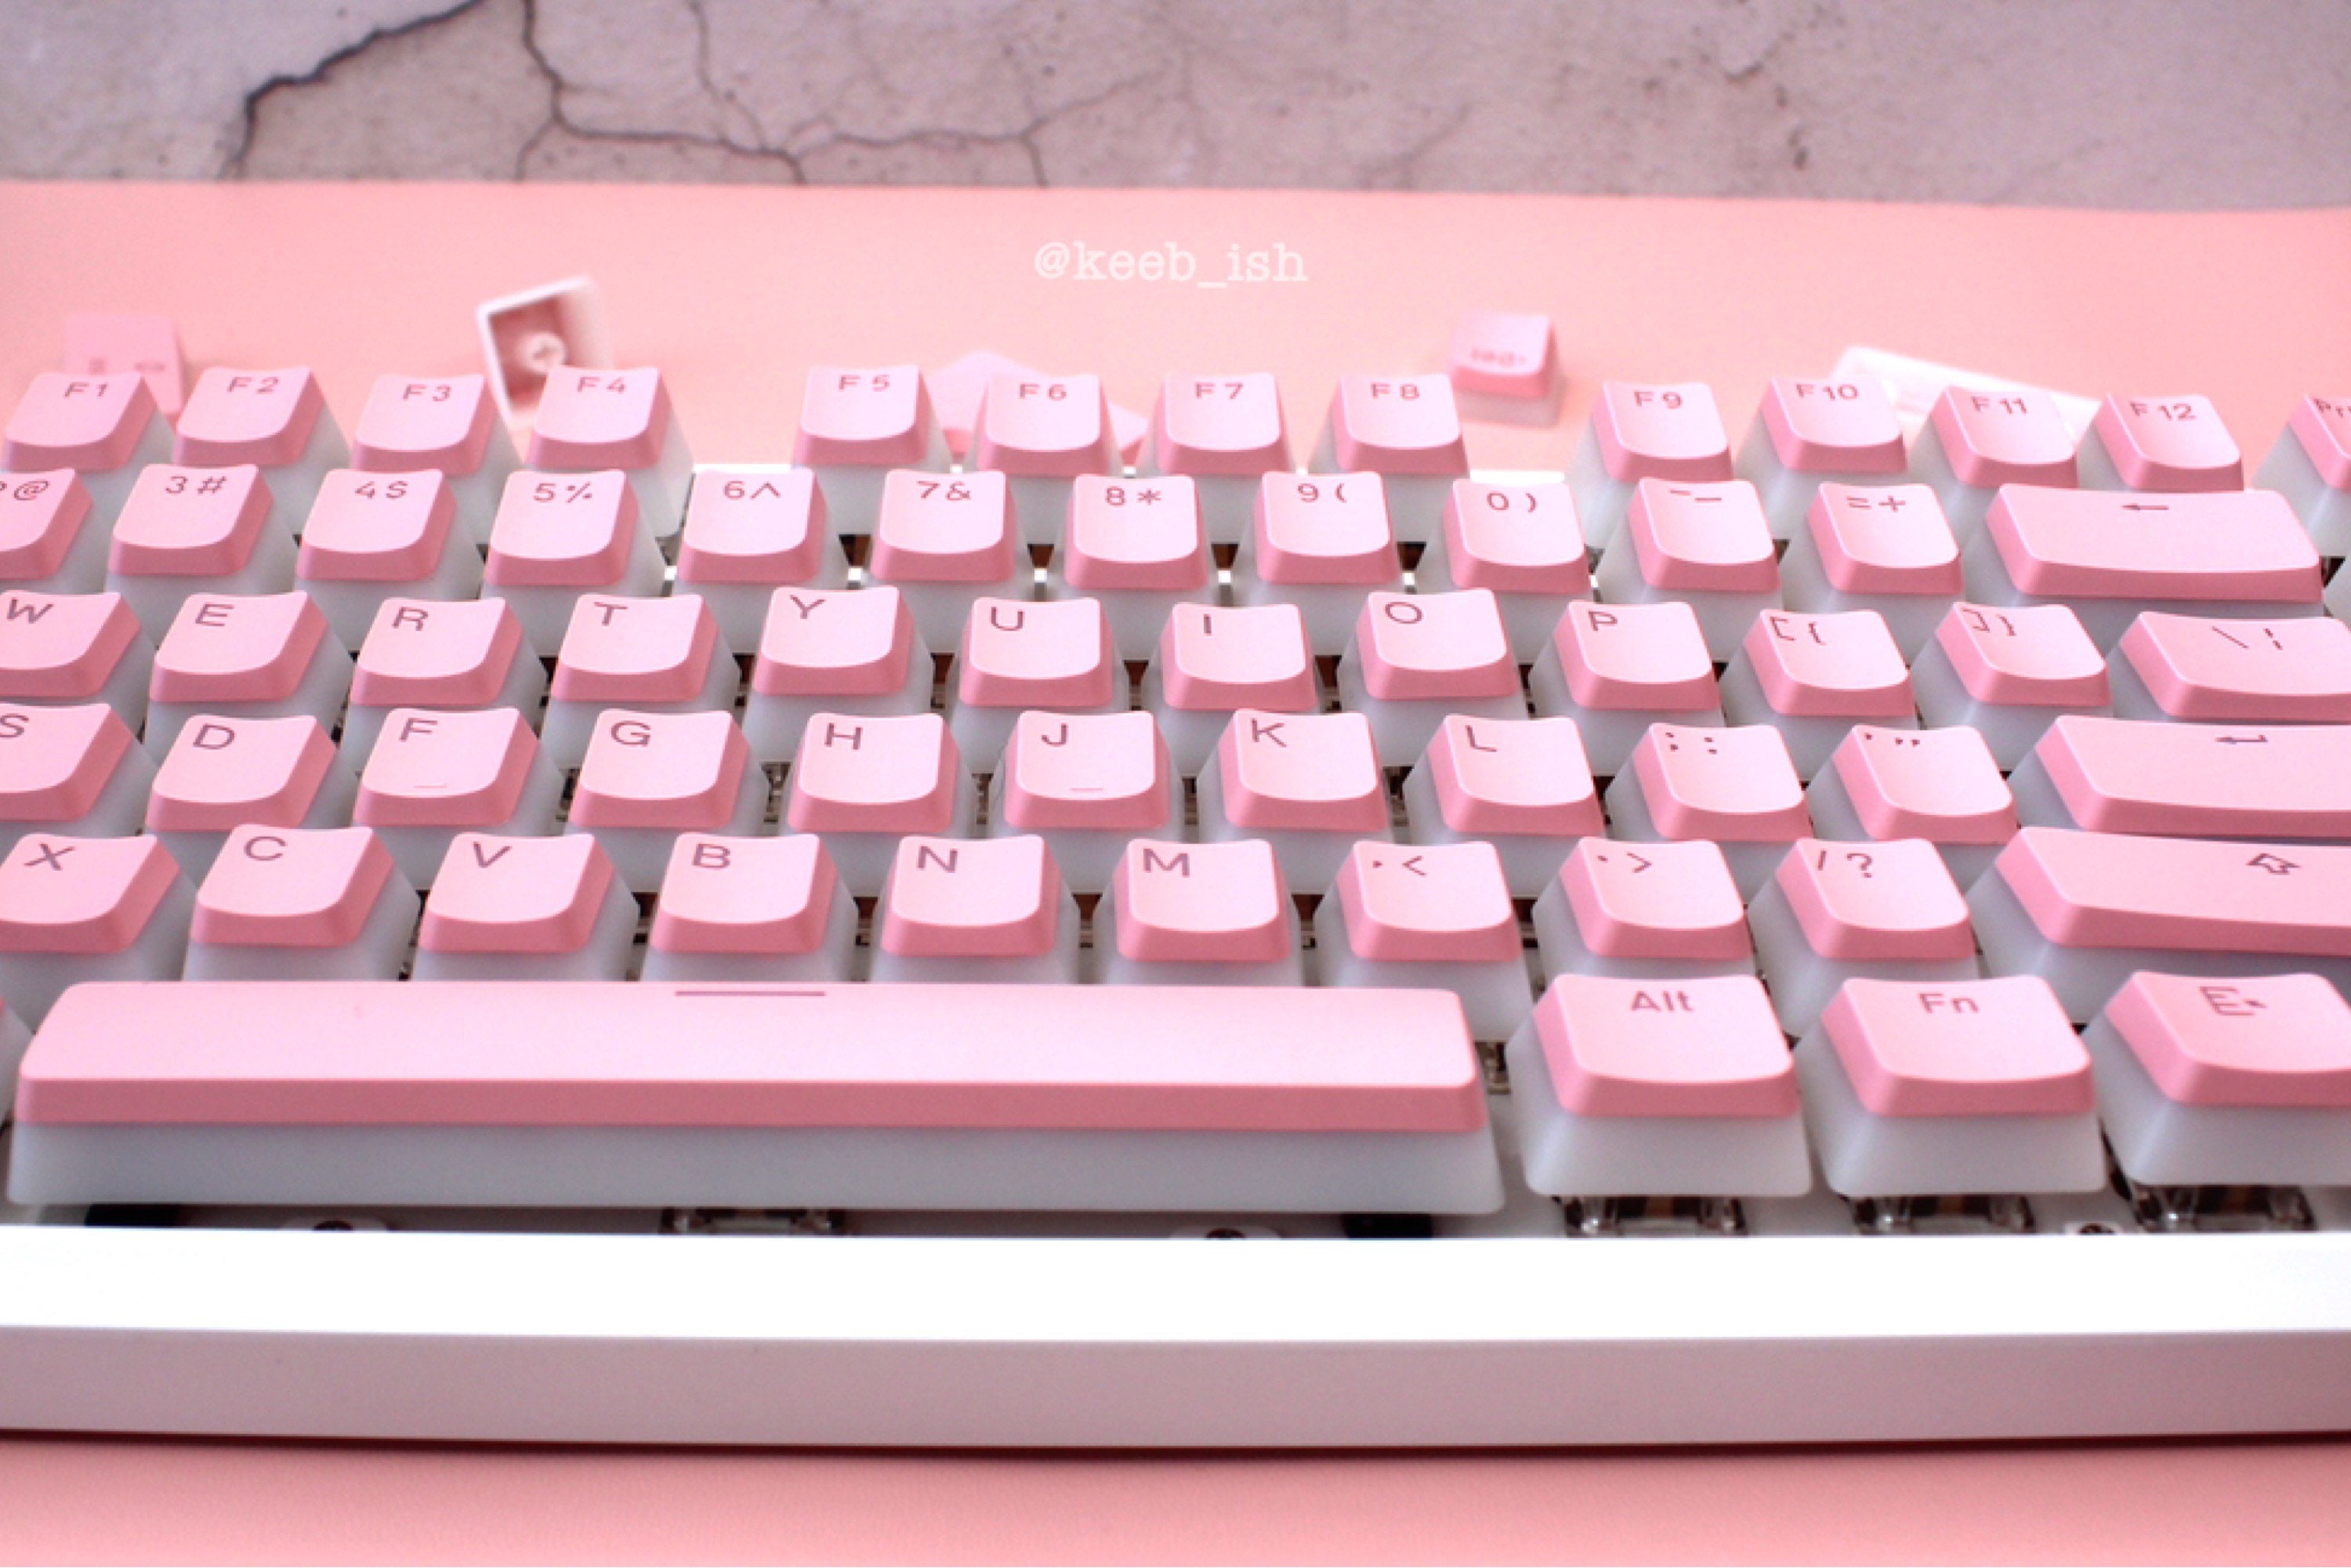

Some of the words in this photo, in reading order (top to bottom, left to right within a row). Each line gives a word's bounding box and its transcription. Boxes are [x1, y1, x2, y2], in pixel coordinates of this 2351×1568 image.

[63, 382, 109, 398] F1
[226, 376, 280, 395] F2
[402, 383, 452, 402] F3
[576, 376, 626, 394] F4
[838, 374, 890, 393] F5
[1018, 382, 1067, 401] F6
[1194, 382, 1244, 400] F7
[1370, 382, 1420, 400] F8
[1795, 383, 1858, 401] F10
[1633, 390, 1683, 409] F9
[1968, 395, 2027, 415] F11
[2128, 400, 2197, 422] F12
[6, 596, 54, 624] W
[194, 602, 234, 627] E
[391, 606, 429, 632] R
[593, 601, 629, 627] T
[789, 594, 825, 620] Y
[990, 606, 1024, 632] U
[1384, 601, 1423, 625] O
[1203, 614, 1212, 636] I
[1587, 610, 1618, 632] P
[0, 712, 30, 739] S
[192, 722, 235, 750] D
[398, 717, 438, 743] F
[610, 720, 651, 748] G
[824, 722, 864, 751] H
[1041, 722, 1069, 748] J
[1251, 717, 1287, 748] K
[1465, 724, 1498, 753] L
[24, 842, 75, 871] X
[243, 835, 287, 862] C
[473, 841, 513, 868] V
[691, 842, 731, 870] B
[916, 845, 958, 874] N
[1143, 847, 1190, 878] M
[1630, 990, 1693, 1012] Alt
[1917, 992, 1979, 1014] Fn
